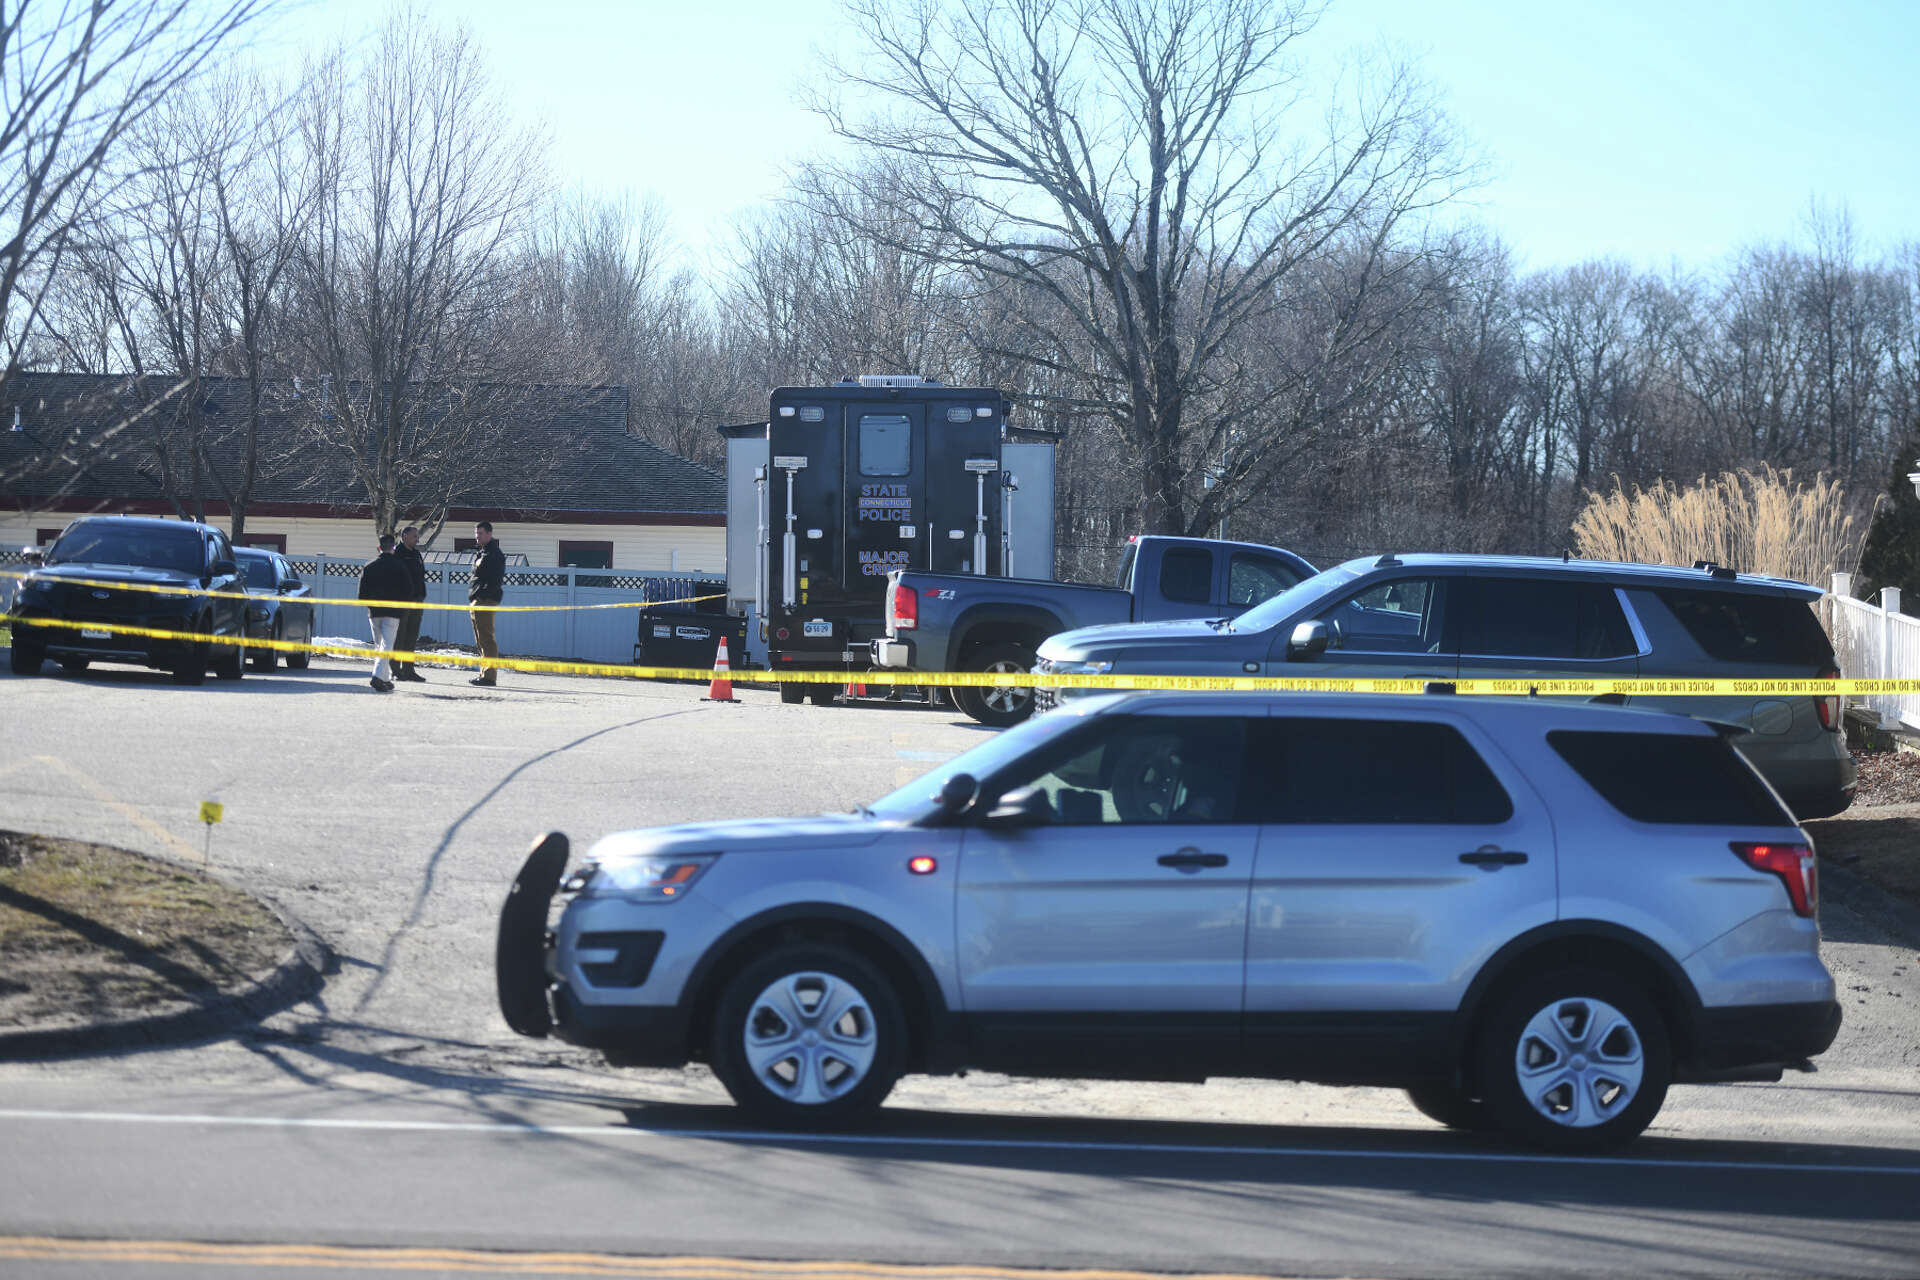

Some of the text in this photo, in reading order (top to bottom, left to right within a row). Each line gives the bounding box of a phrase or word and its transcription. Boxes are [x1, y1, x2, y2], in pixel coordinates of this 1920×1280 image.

[862, 484, 907, 496] STATE
[860, 498, 910, 506] CONNECTICUT
[860, 509, 911, 521] POLICE
[859, 551, 910, 563] MAJOR
[1492, 681, 1518, 691] CROSS
[1537, 681, 1547, 691] DO
[1549, 681, 1566, 691] LINE
[1568, 681, 1594, 691] POLICE
[1612, 682, 1715, 692] POLICE LINE DO NOT CROSS
[1733, 681, 1836, 692] POLICE LINE DO NOT CROSS
[1854, 681, 1879, 691] CROSS
[1882, 681, 1896, 691] NOT
[1899, 681, 1909, 691] DO
